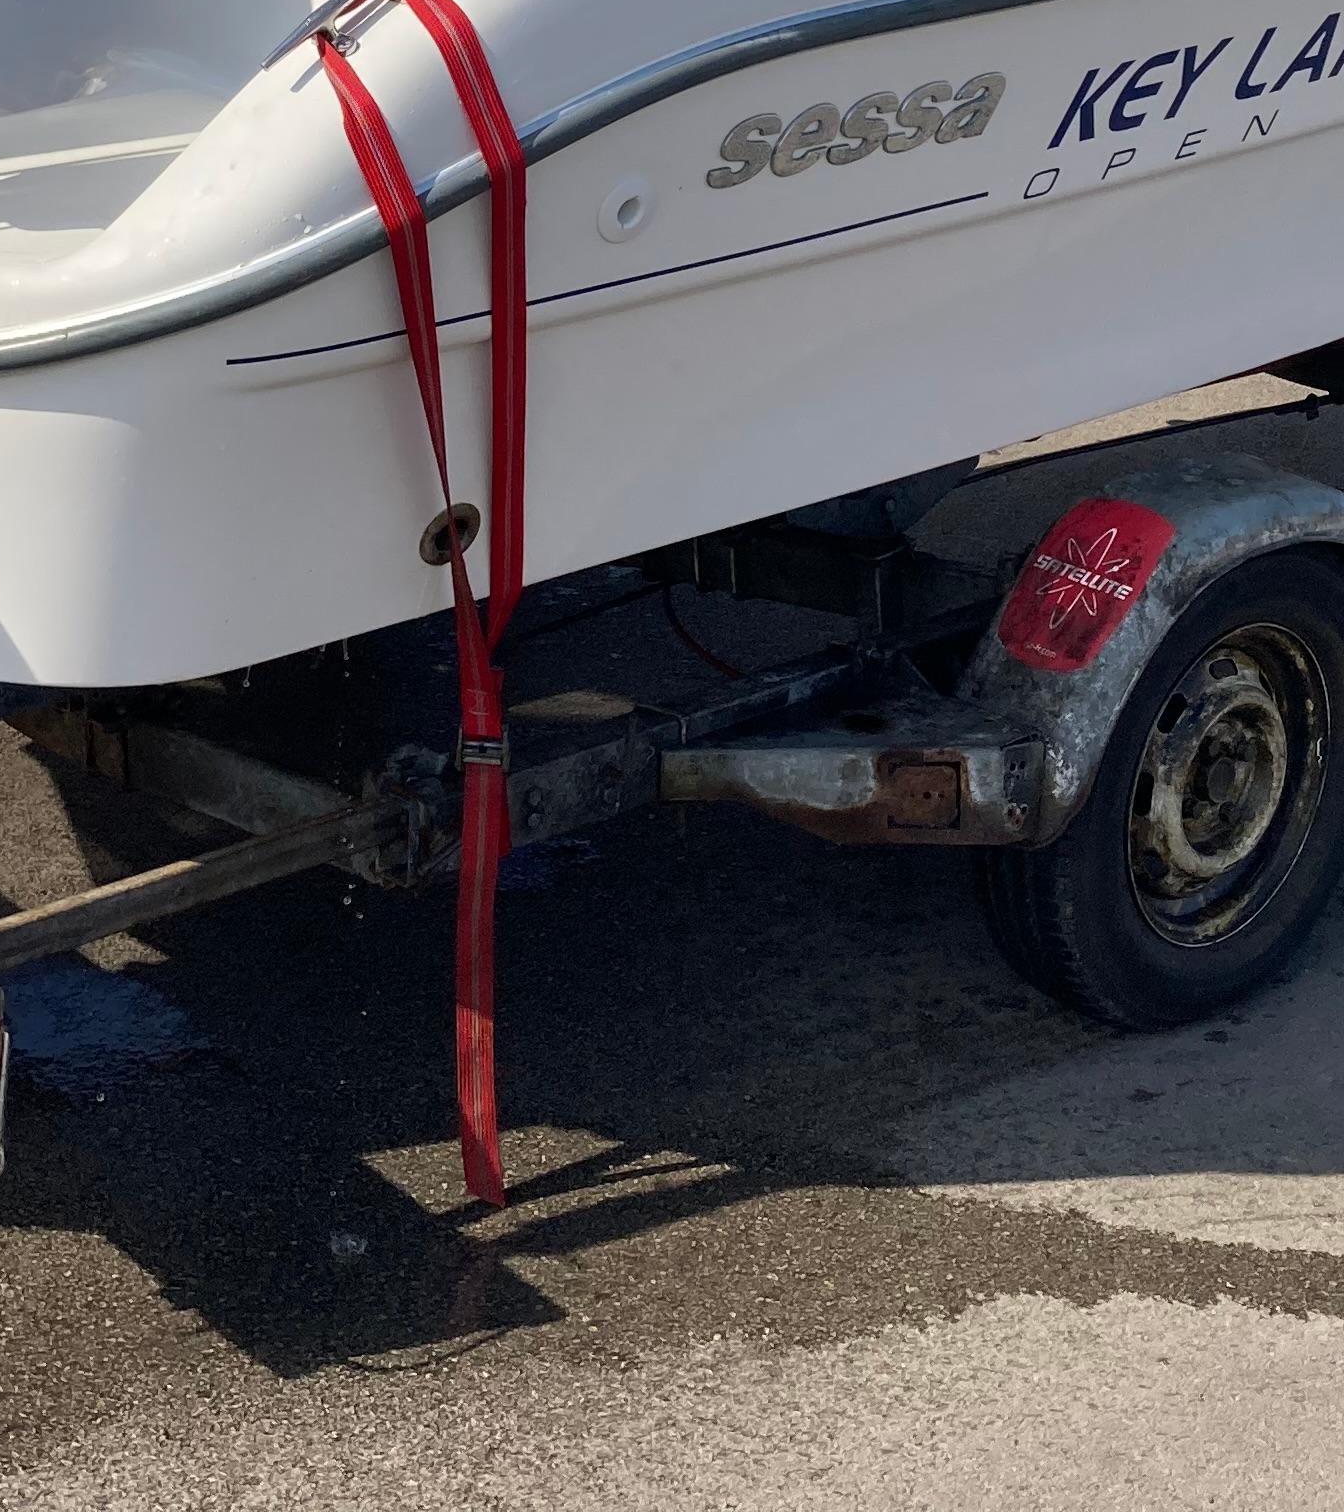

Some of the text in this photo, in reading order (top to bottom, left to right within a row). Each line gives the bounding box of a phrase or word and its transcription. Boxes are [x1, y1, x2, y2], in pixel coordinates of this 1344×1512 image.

[706, 71, 1007, 190] sessa
[1046, 36, 1234, 150] KEY
[1022, 109, 1280, 200] OPEN
[1033, 554, 1134, 601] SATELLITE
